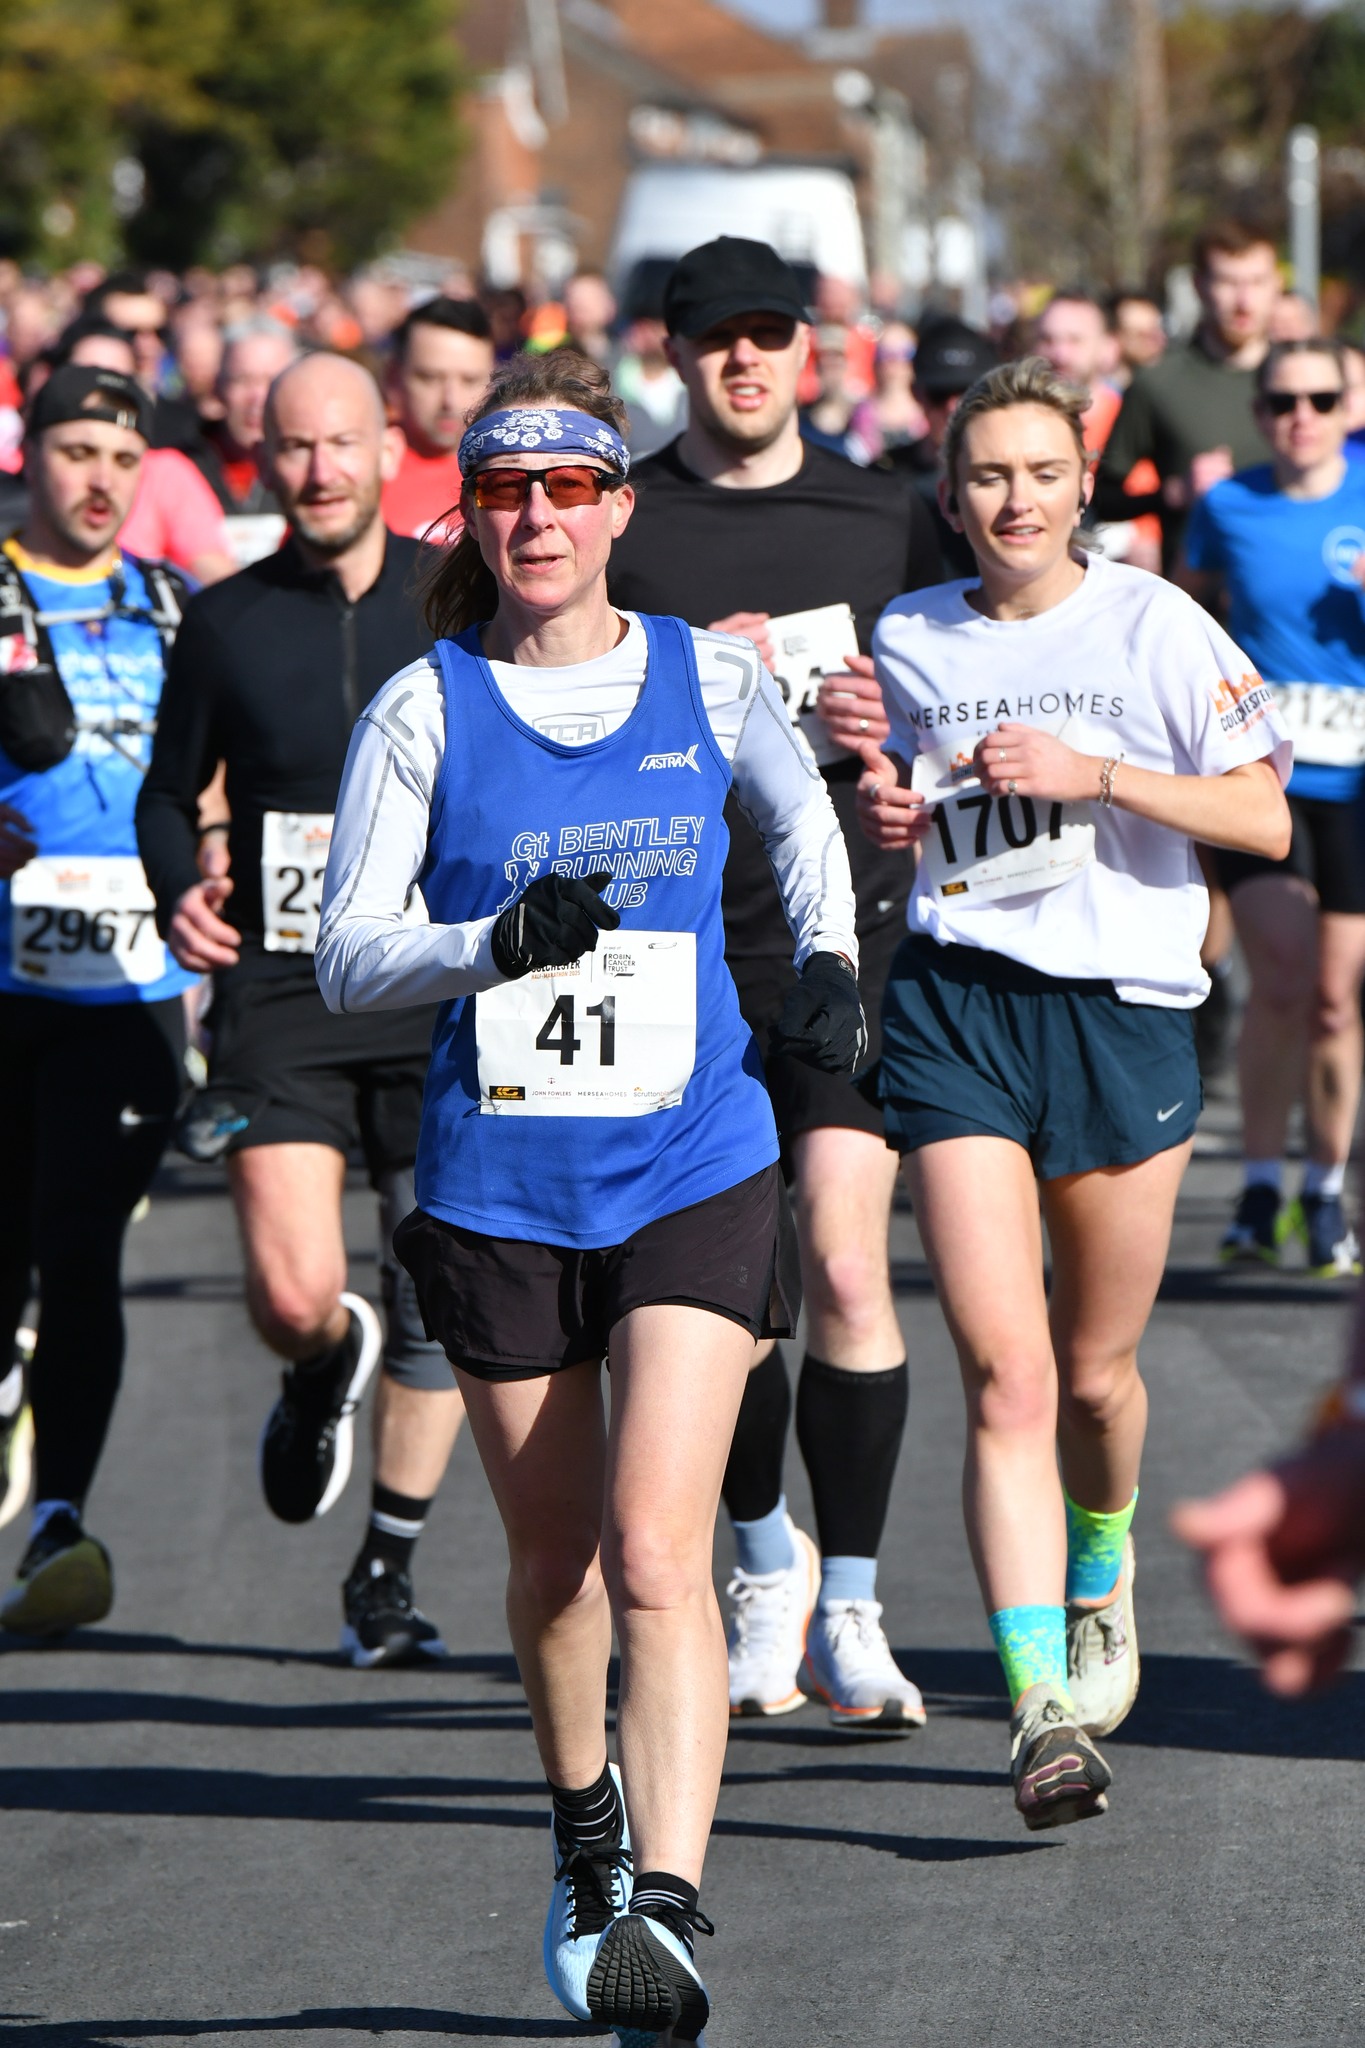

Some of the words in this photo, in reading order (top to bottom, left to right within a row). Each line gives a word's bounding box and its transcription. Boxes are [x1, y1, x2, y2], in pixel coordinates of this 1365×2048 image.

[909, 692, 1125, 731] MERSEAHOMES
[539, 722, 597, 742] TCA
[638, 743, 701, 773] FASTRAX
[511, 831, 550, 860] Gt
[558, 816, 705, 856] BENTLEY
[550, 847, 697, 880] RUNNING
[603, 882, 647, 909] UB
[22, 905, 153, 953] 2967
[536, 995, 616, 1066] 41
